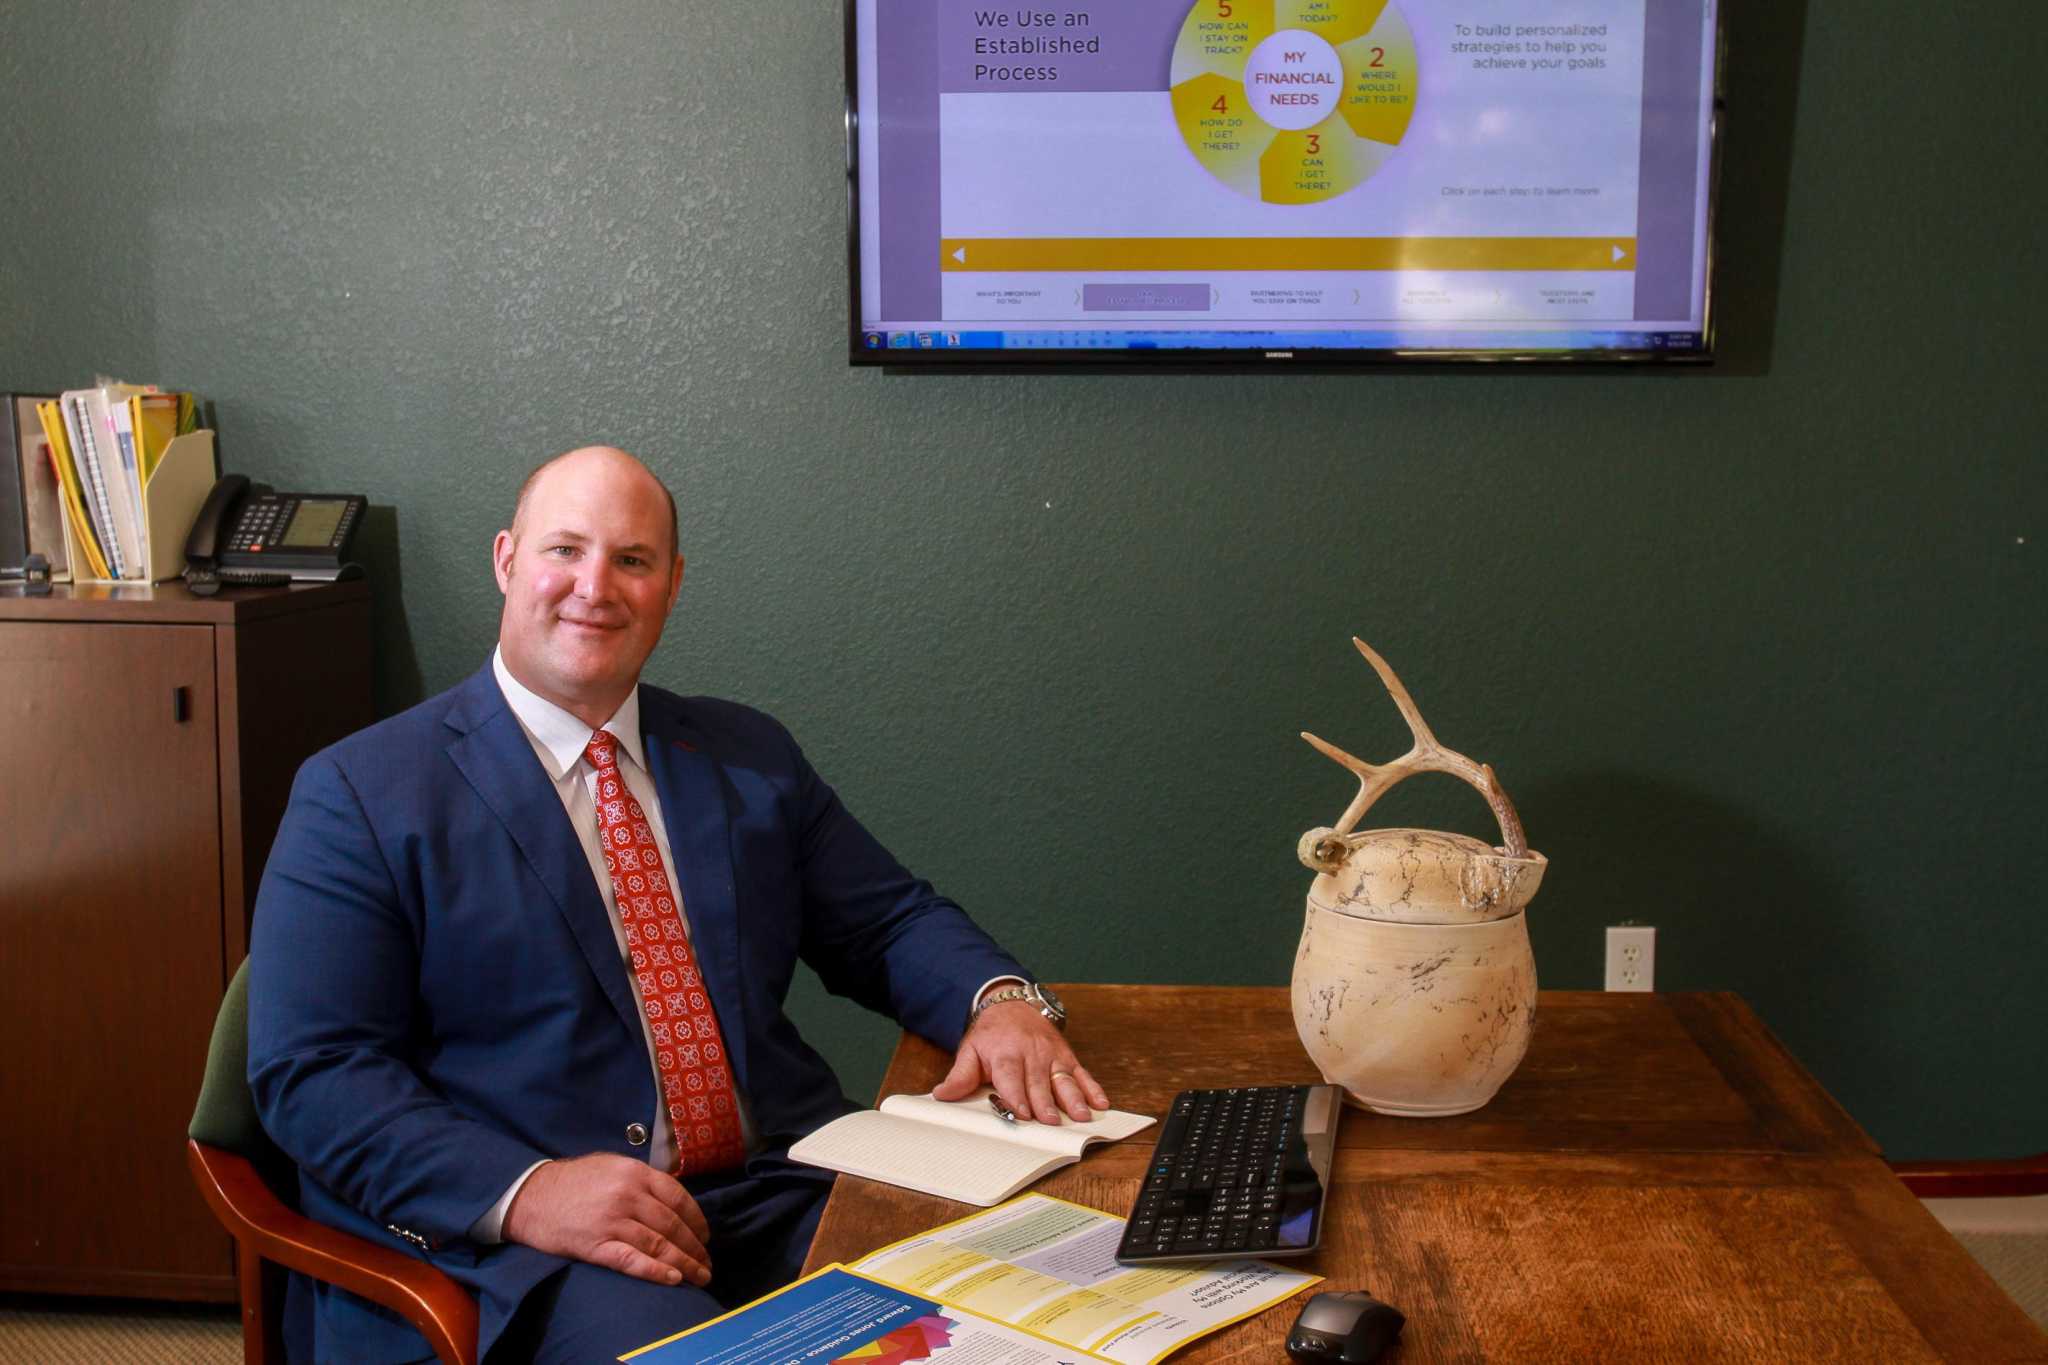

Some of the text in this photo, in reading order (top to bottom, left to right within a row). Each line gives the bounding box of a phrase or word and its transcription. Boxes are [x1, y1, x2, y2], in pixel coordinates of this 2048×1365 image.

[1217, 0, 1233, 18] 5
[974, 10, 1089, 27] We Use an
[1300, 15, 1338, 23] TODAY?
[1455, 24, 1607, 38] To build personalized
[975, 36, 1100, 54] Established
[1205, 46, 1244, 54] TRACK?
[1451, 41, 1607, 55] strategies to help you
[1284, 52, 1306, 63] MY
[1370, 47, 1385, 68] 2
[1473, 57, 1606, 71] achieve your goals
[975, 64, 1058, 81] Process
[1256, 73, 1335, 84] FINANCIAL
[1361, 72, 1397, 80] WHERE
[1358, 84, 1394, 92] WOULD
[1211, 95, 1228, 114] 4
[1270, 94, 1319, 105] NEEDS
[1374, 96, 1387, 104] TO
[1200, 119, 1242, 127] HOW DO
[1214, 131, 1233, 139] GET
[1203, 143, 1240, 151] THERE?
[1306, 135, 1320, 154] 3
[1302, 159, 1323, 167] CAN
[1294, 182, 1331, 190] THERE?
[1205, 1289, 1223, 1297] with
[1200, 1294, 1233, 1308] Options
[876, 1304, 912, 1324] Edward
[849, 1321, 877, 1337] Jones
[806, 1335, 850, 1357] Guidance
